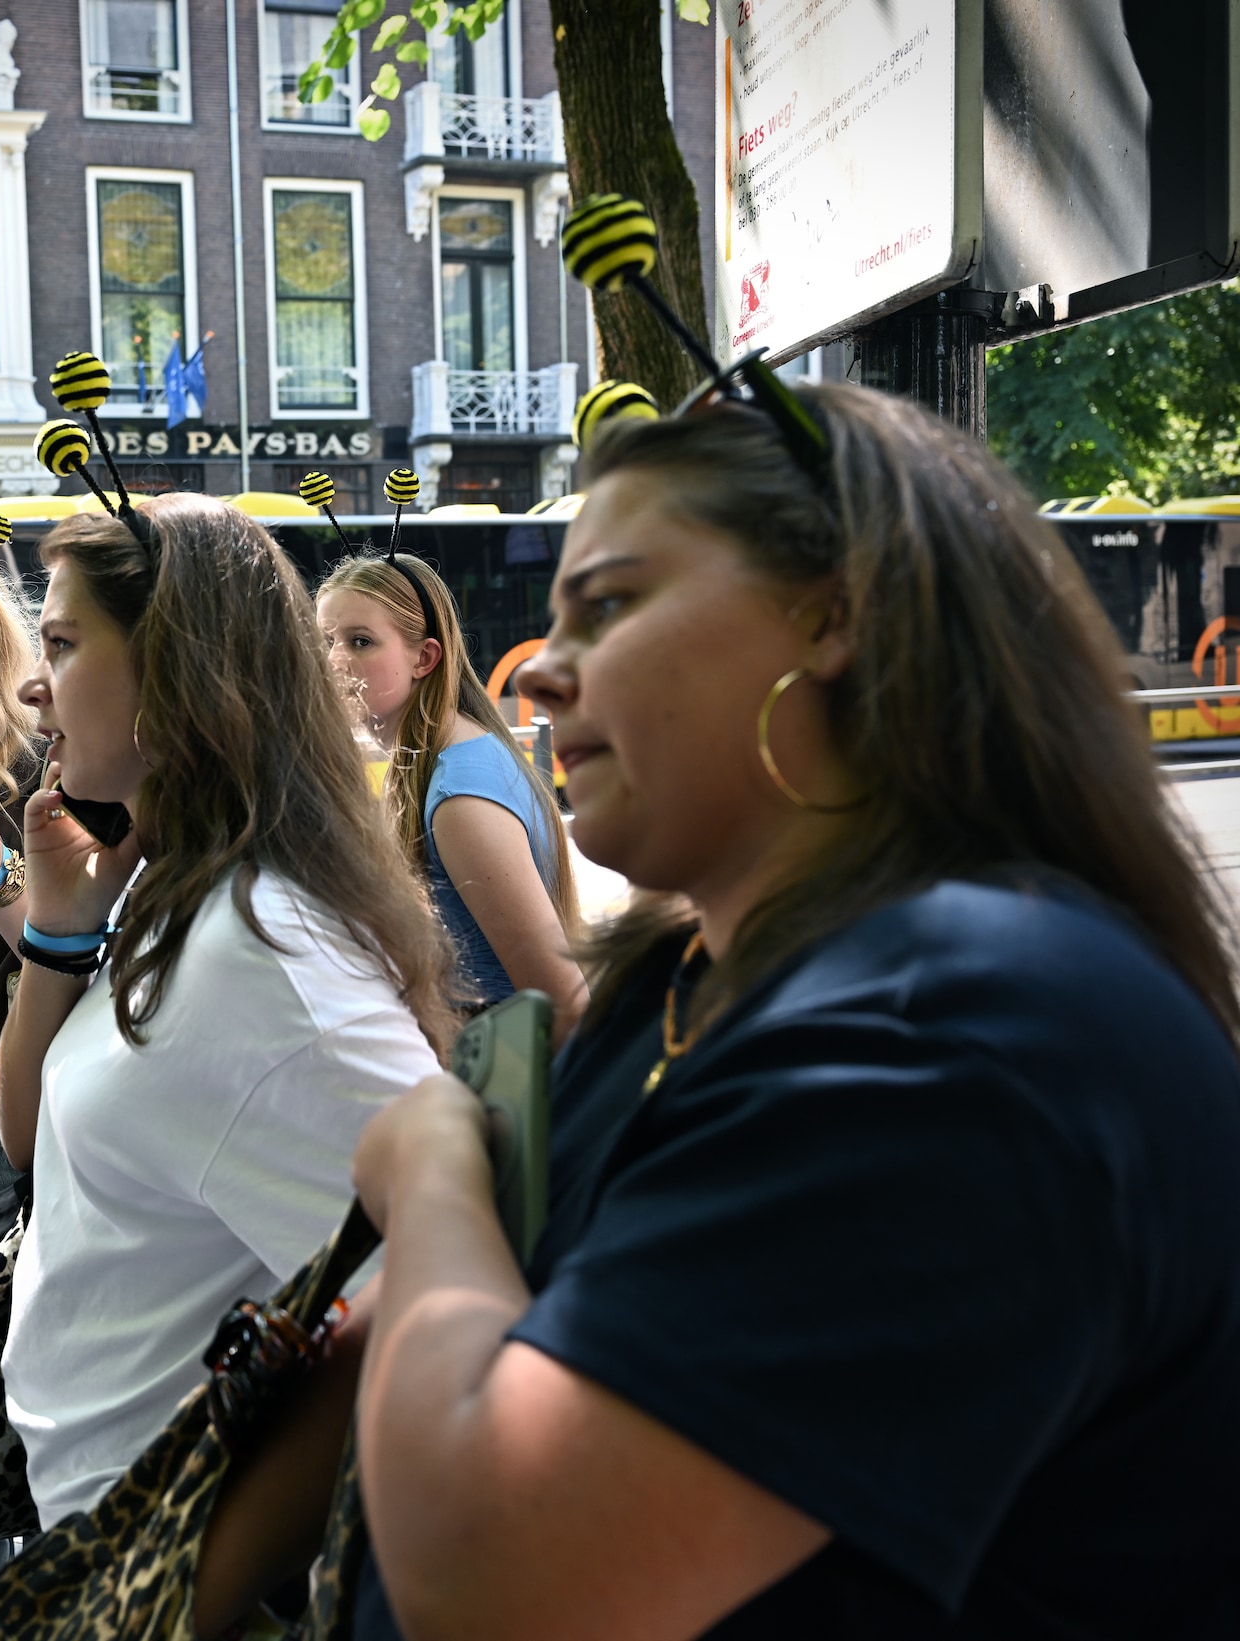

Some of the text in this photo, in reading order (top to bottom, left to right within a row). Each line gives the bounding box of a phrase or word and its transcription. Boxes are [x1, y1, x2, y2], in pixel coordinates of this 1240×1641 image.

[743, 38, 772, 71] maximaal
[784, 12, 803, 37] dagen
[743, 74, 759, 100] houd
[794, 32, 811, 54] loop-
[812, 20, 821, 37] en
[738, 22, 930, 188] De gemeente haalt regelmatig fietsen weg die gevaarlijk
[738, 91, 798, 161] Fiets weg?
[738, 191, 745, 209] of
[753, 180, 766, 198] lang
[768, 148, 802, 191] geparkeerd
[825, 120, 839, 142] Kijk
[841, 115, 850, 132] op
[914, 52, 923, 74] of
[738, 211, 747, 231] bel
[766, 190, 777, 211] 286
[854, 223, 932, 278] Utrecht.nl/fiets
[732, 327, 756, 348] Gemeente
[91, 431, 372, 457] DES PAYS-BAS
